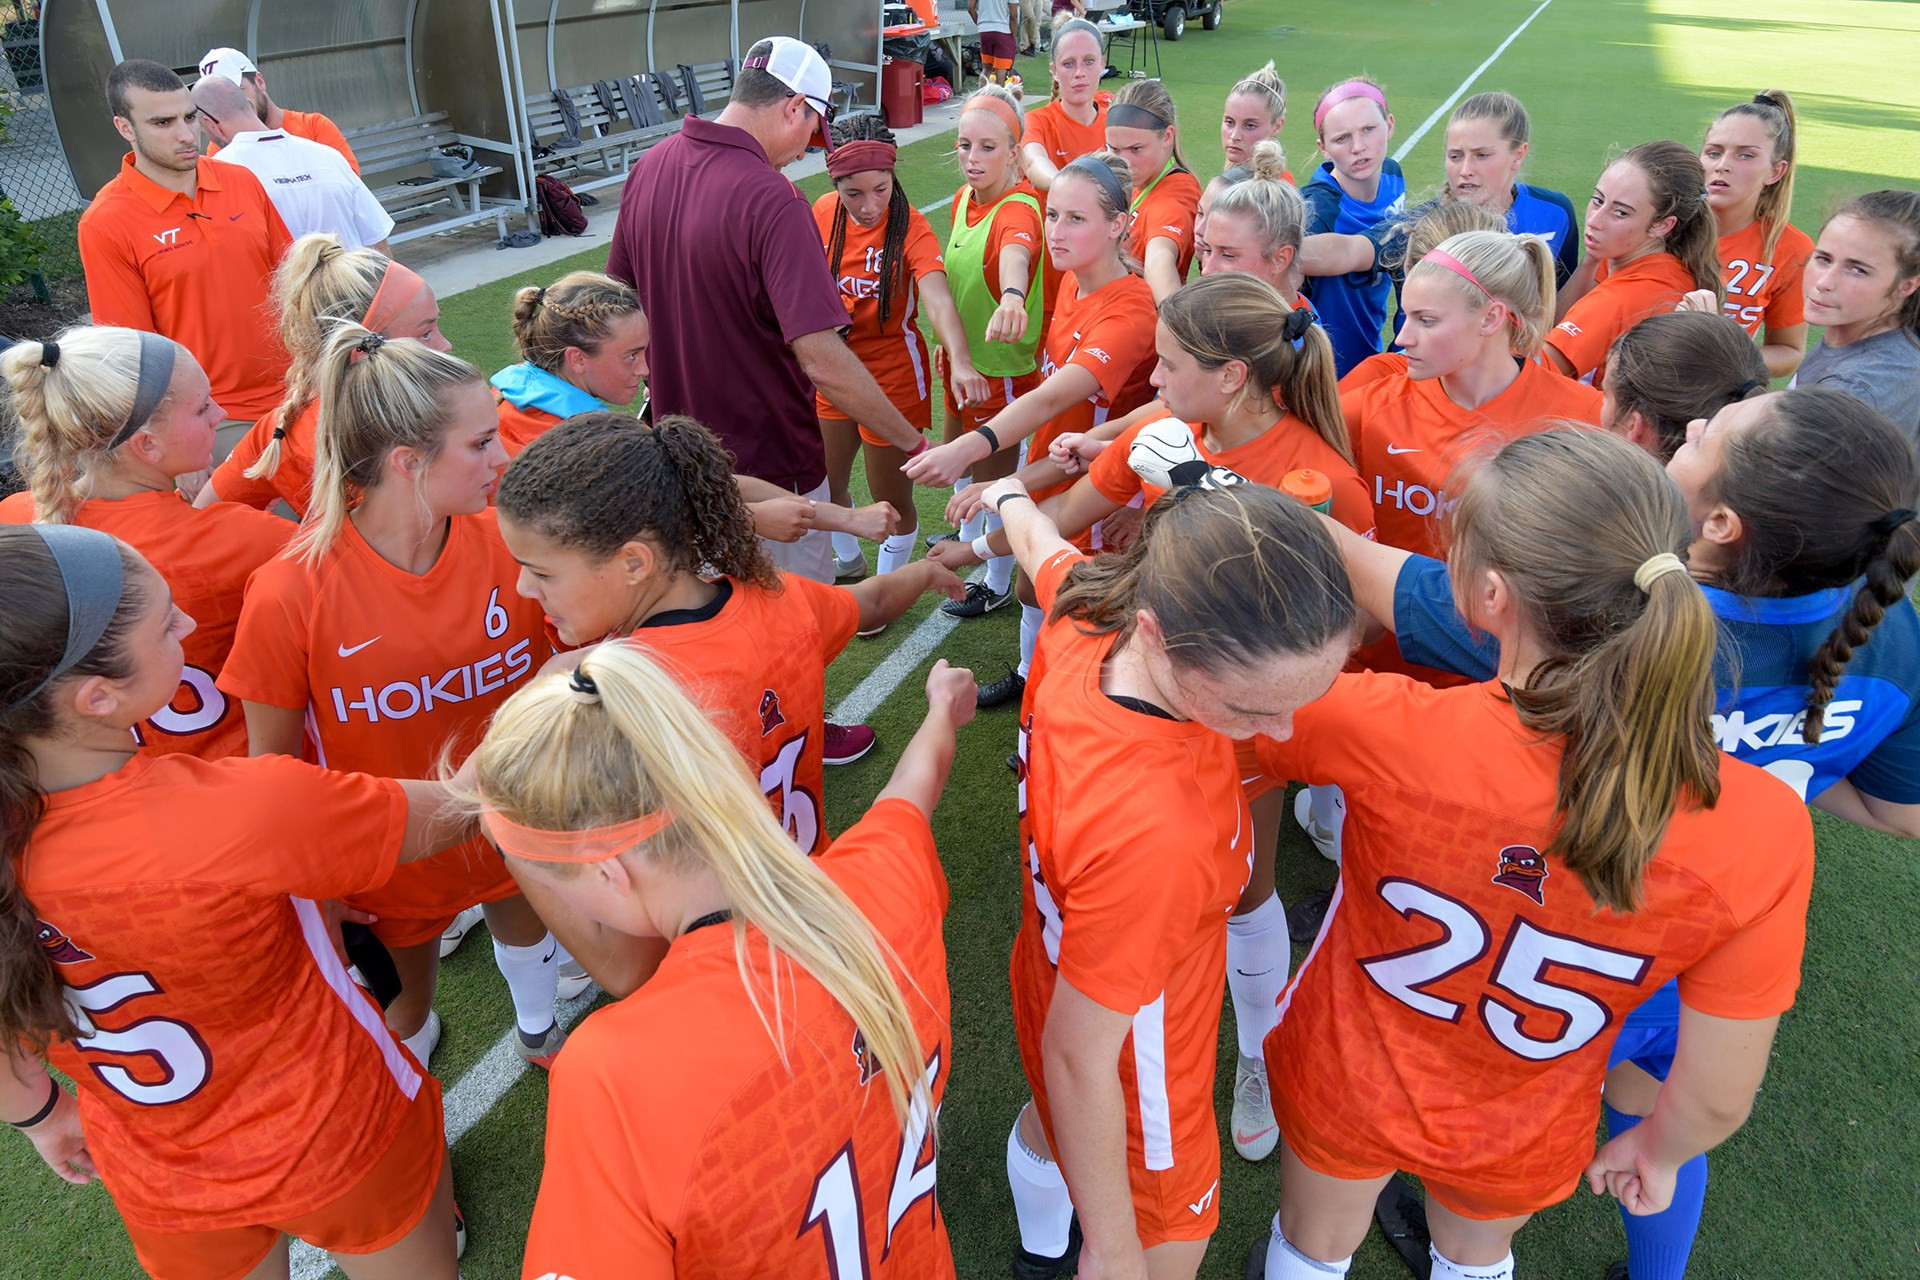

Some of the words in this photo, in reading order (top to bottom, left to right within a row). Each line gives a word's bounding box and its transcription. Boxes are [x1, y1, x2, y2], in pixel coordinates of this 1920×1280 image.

[201, 60, 219, 76] VT
[295, 174, 312, 182] TECH
[152, 226, 181, 245] VT
[1727, 258, 1776, 297] 27
[1555, 320, 1583, 337] ACC
[1082, 346, 1112, 365] ACC
[484, 584, 510, 640] 6
[330, 637, 532, 723] HOKIES
[1356, 875, 1656, 1062] 25
[1187, 1178, 1219, 1216] VT
